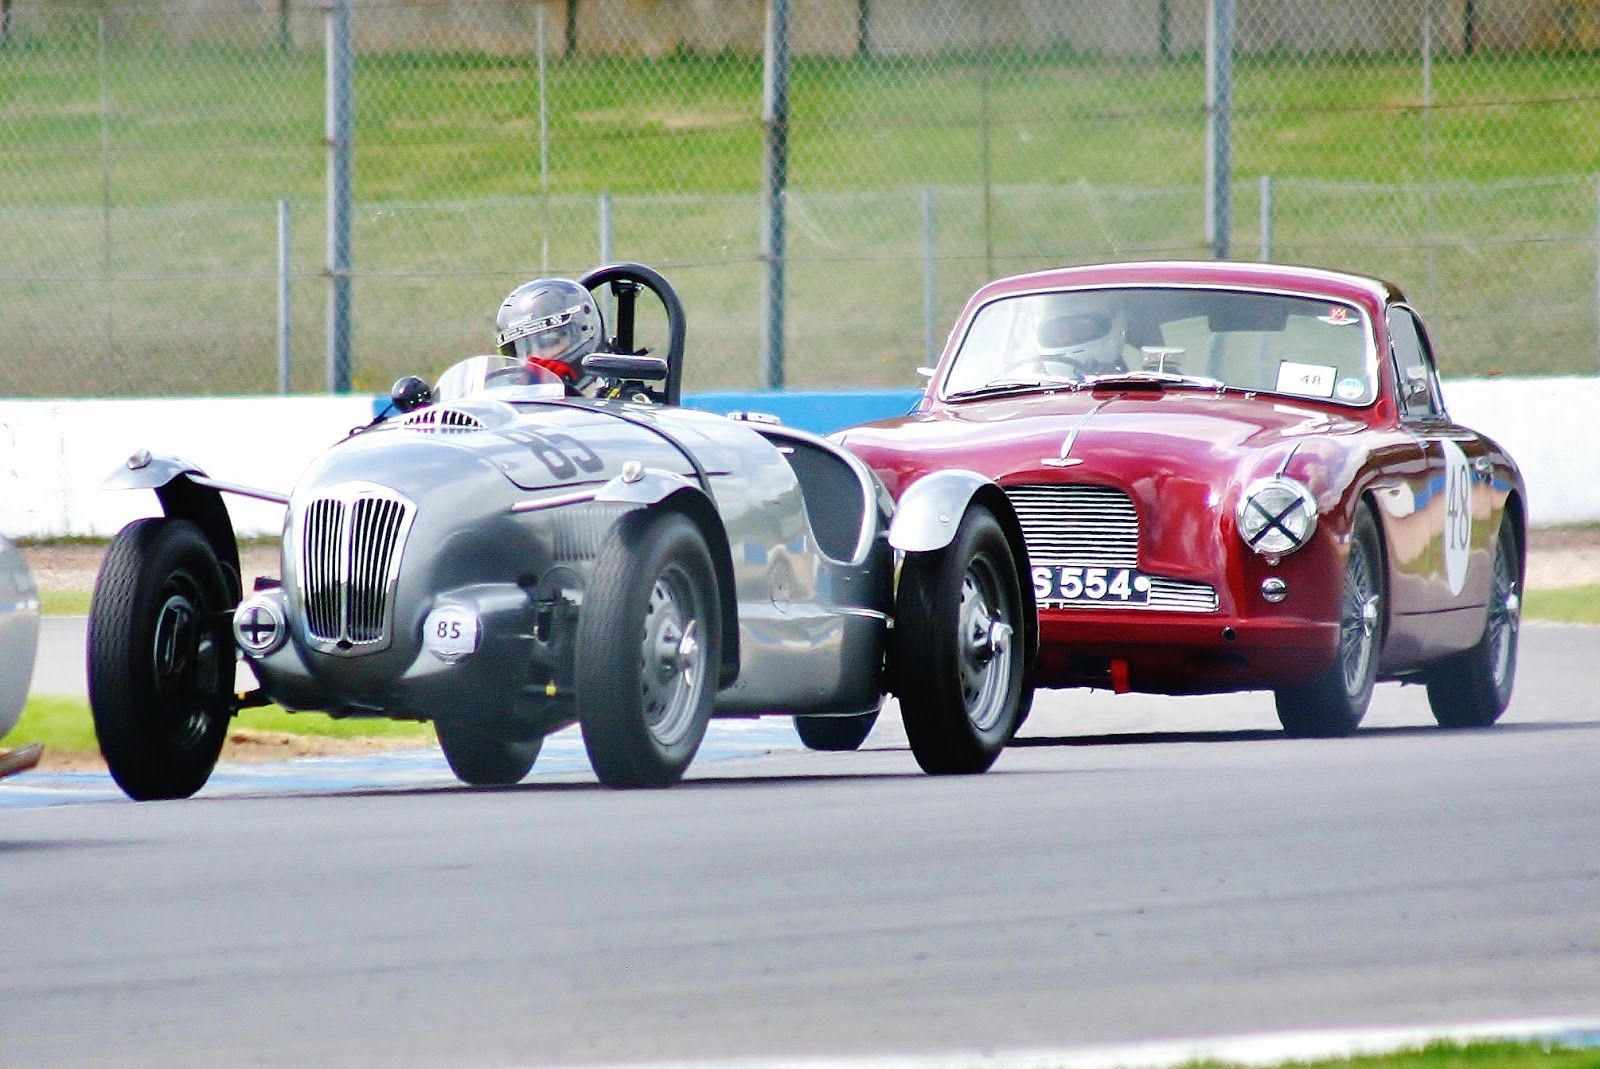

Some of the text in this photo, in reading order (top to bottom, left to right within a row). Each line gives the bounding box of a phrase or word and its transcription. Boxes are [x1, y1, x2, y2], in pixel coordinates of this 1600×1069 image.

[1300, 374, 1322, 387] 48
[494, 424, 604, 480] 85
[1447, 464, 1470, 551] 48
[1032, 567, 1132, 600] S 554
[437, 621, 461, 639] 85
